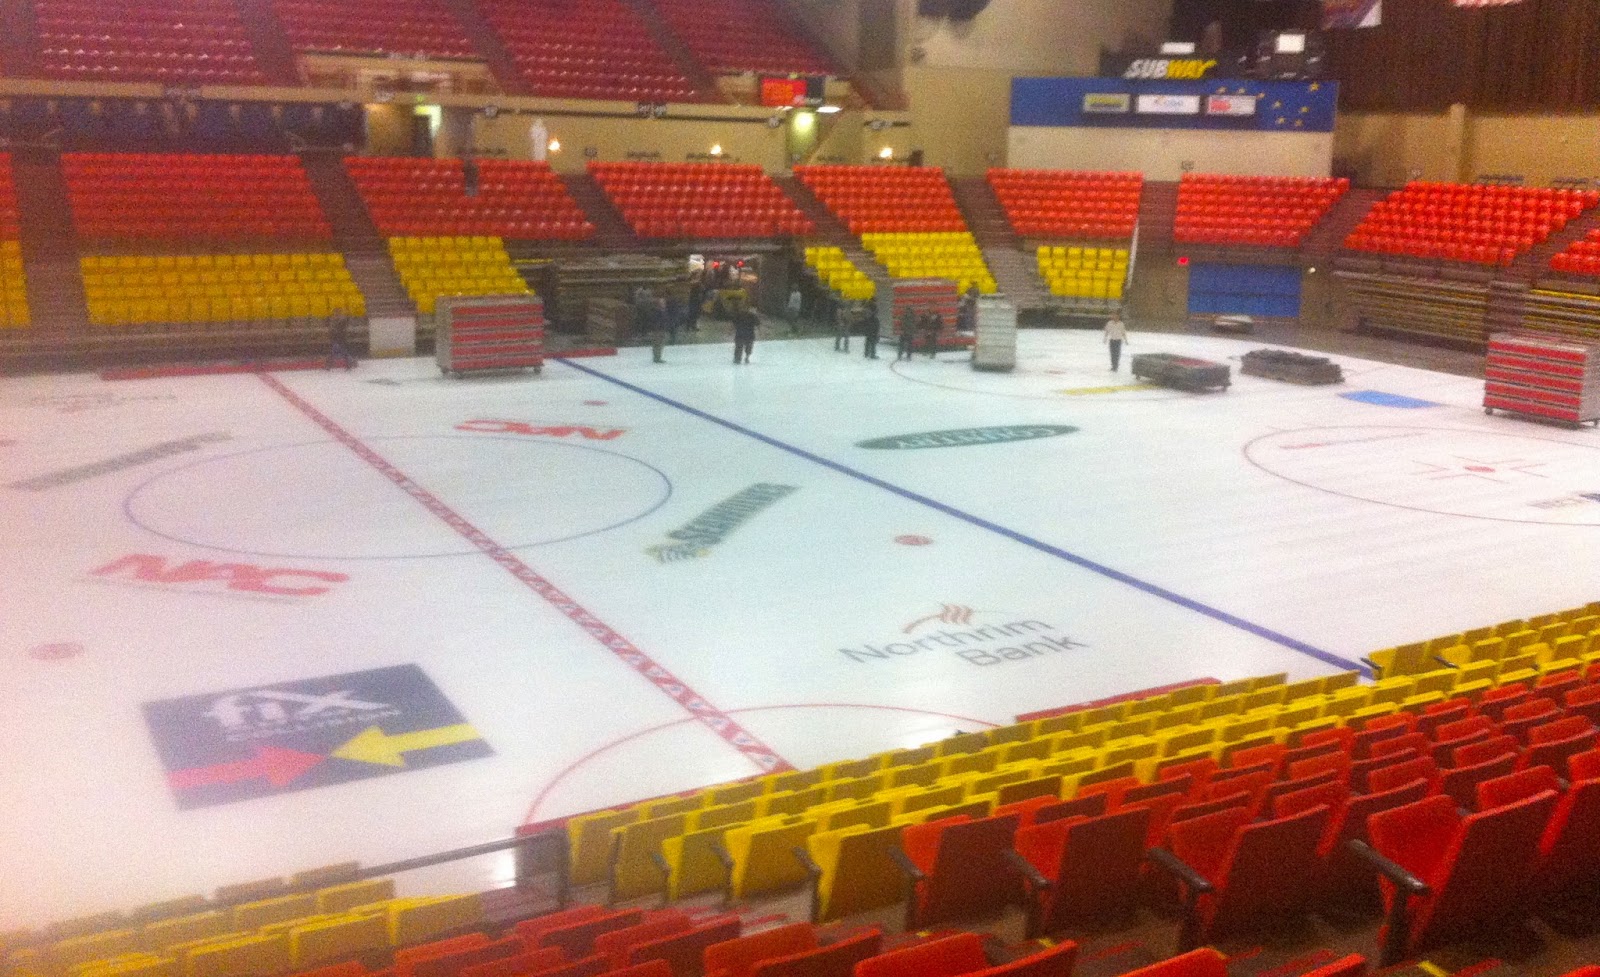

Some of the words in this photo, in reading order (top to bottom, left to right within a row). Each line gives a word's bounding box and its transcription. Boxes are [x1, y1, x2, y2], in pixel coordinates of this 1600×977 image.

[1124, 58, 1217, 79] SUBWAY
[838, 619, 1055, 663] Northrim
[955, 634, 1090, 666] Bank
